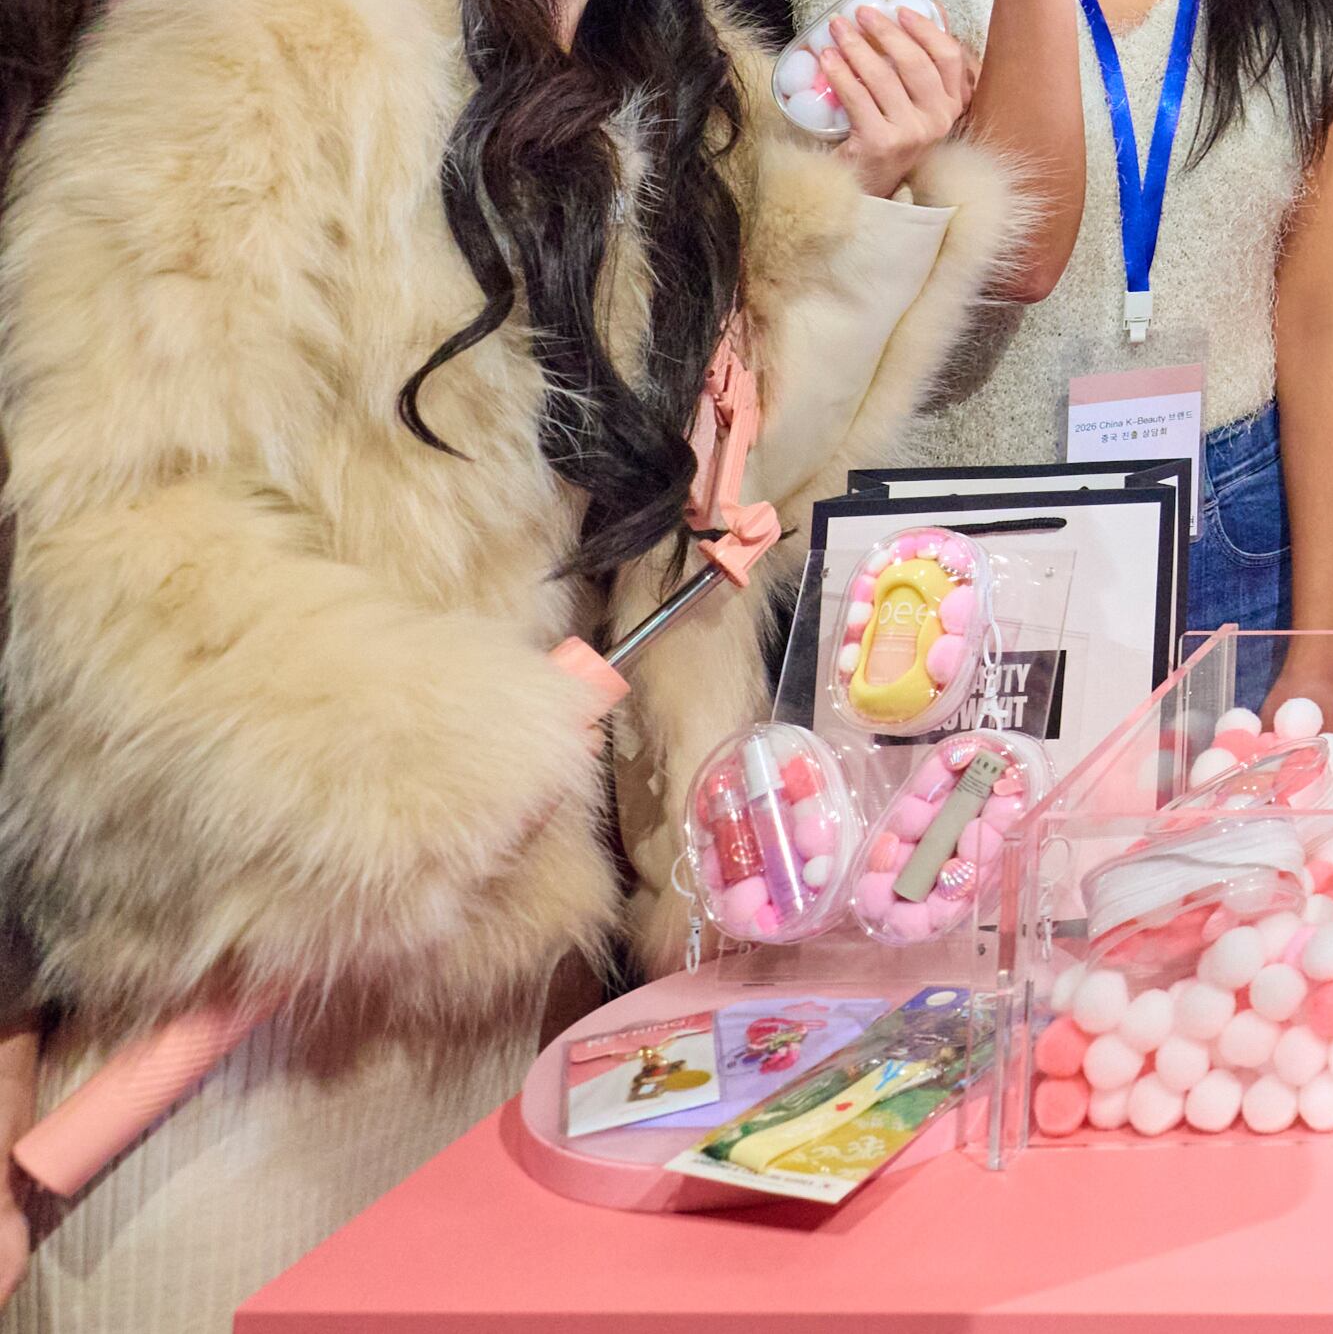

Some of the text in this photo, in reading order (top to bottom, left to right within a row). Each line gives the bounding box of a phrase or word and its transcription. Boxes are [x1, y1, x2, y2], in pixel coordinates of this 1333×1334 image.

[1075, 410, 1193, 433] 2026 China K-Beauty 브랜드
[1101, 427, 1167, 443] 중국 진출 상담회
